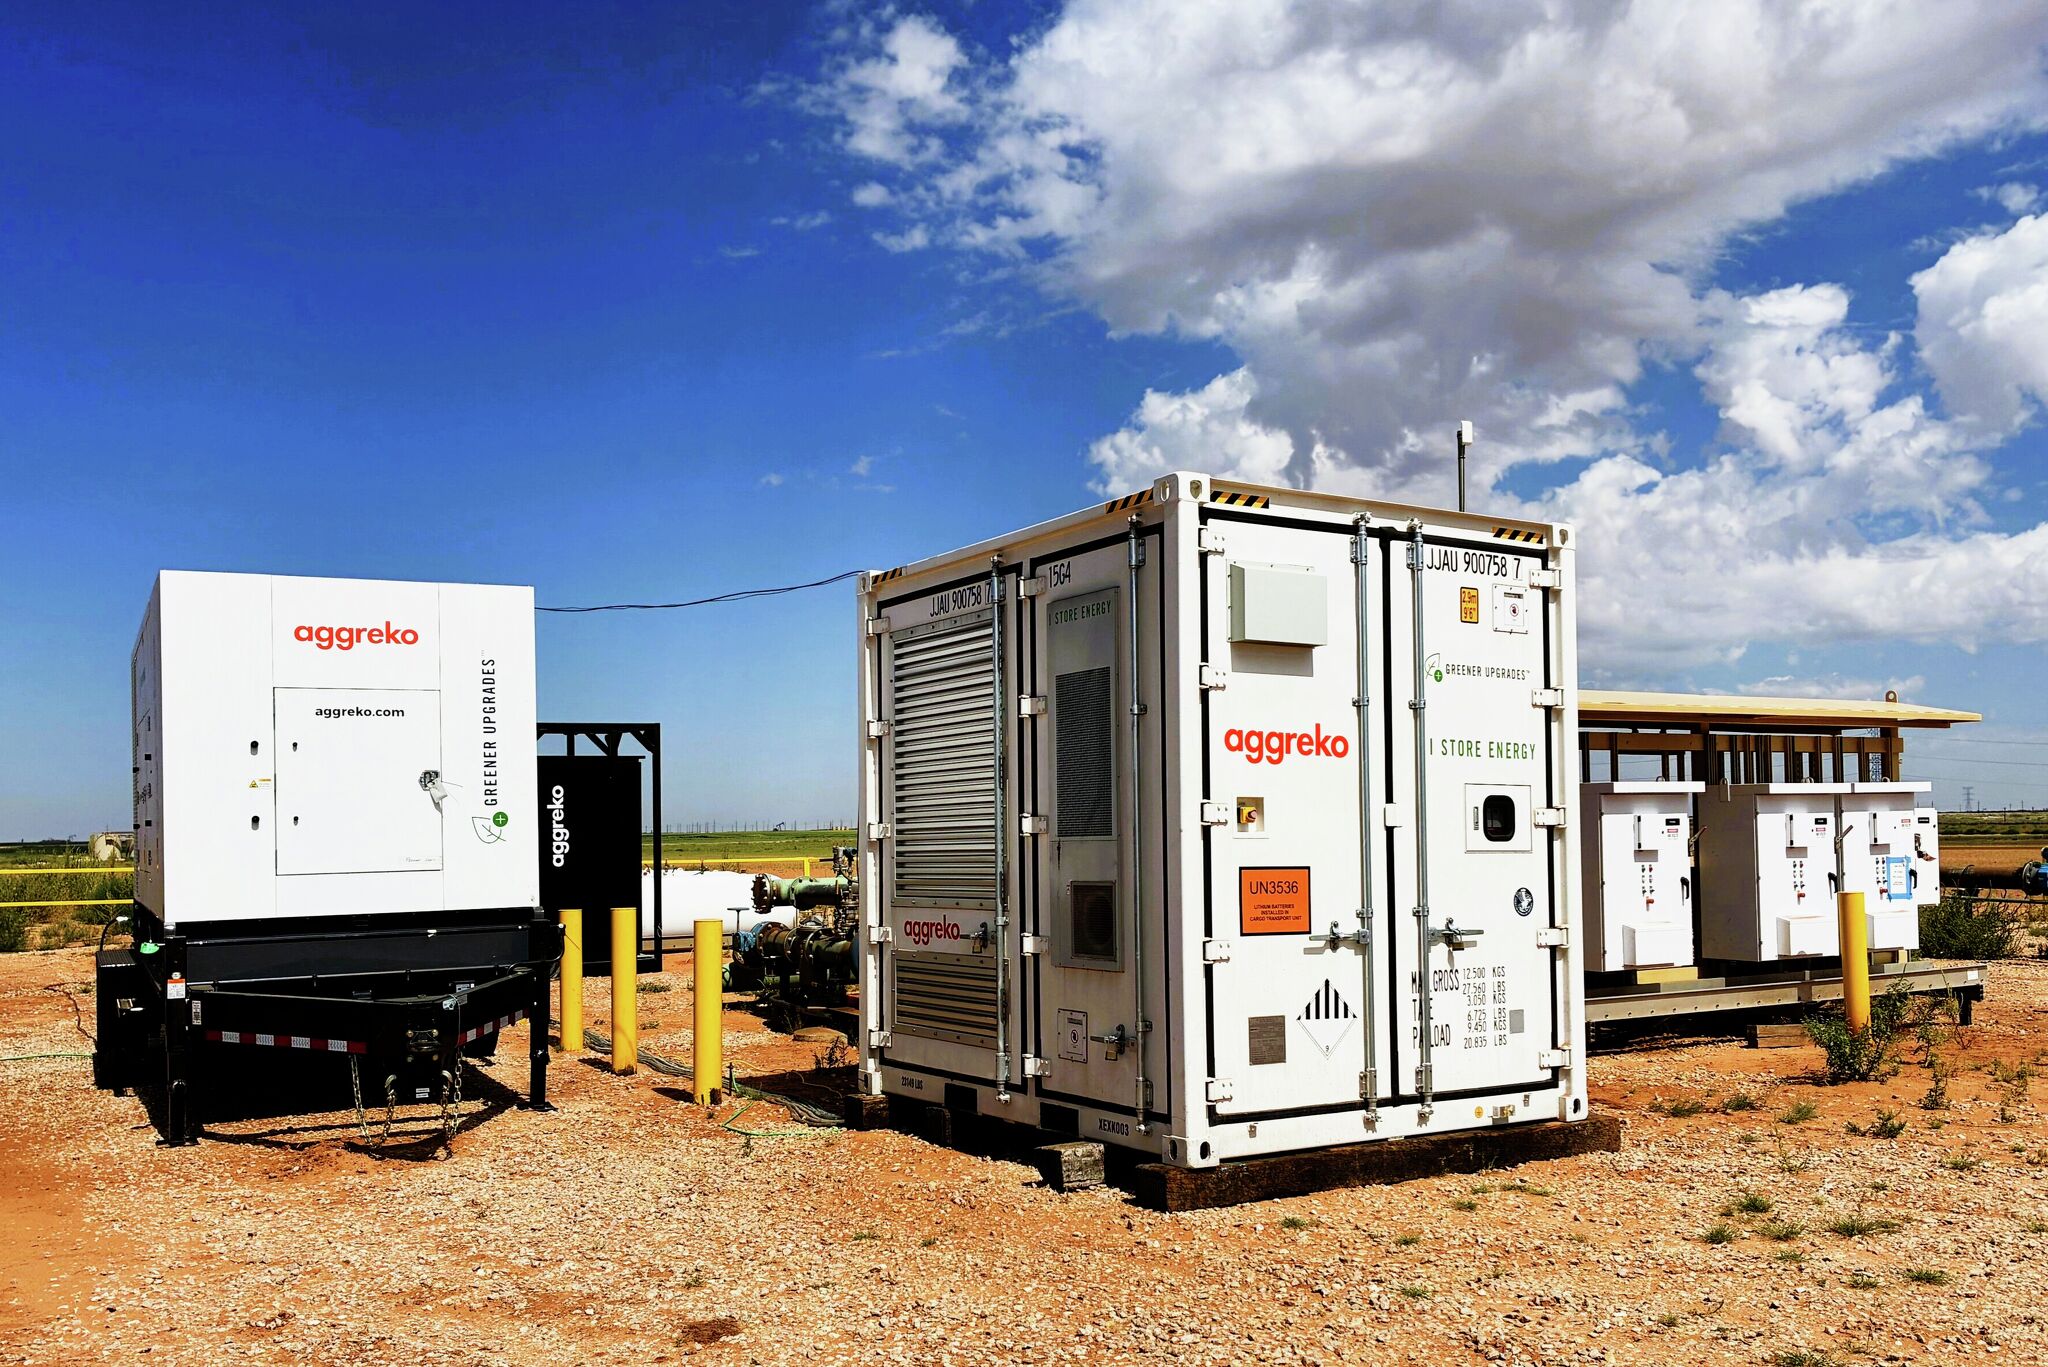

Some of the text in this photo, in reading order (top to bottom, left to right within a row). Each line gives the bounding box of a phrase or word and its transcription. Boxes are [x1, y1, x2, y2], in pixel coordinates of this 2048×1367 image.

[1049, 561, 1071, 588] 15G4
[1426, 548, 1521, 579] JJAU 900758 7
[929, 592, 950, 617] JJAU
[952, 584, 982, 611] 900758
[1054, 607, 1078, 625] STORE
[1081, 600, 1111, 619] ENERGY
[293, 620, 419, 651] aggreko
[1445, 663, 1482, 677] GREENER
[315, 706, 405, 719] aggreko.com
[1224, 723, 1349, 765] aggreko
[1441, 738, 1482, 758] STORE
[1488, 741, 1536, 760] ENERGY
[483, 741, 498, 806] GREENER
[546, 784, 570, 868] aggreko
[1249, 880, 1299, 895] UN3536
[903, 914, 961, 946] aggreko
[1492, 966, 1506, 978] KGS
[1462, 981, 1506, 995] 27.560 LBS
[1466, 994, 1486, 1006] 3.050
[1492, 993, 1506, 1005] KGS
[1467, 1008, 1507, 1022] 6.725 LBS
[1412, 1019, 1507, 1049] PALOAD 9.450 KGS
[1464, 1034, 1507, 1049] 20.835 LBS
